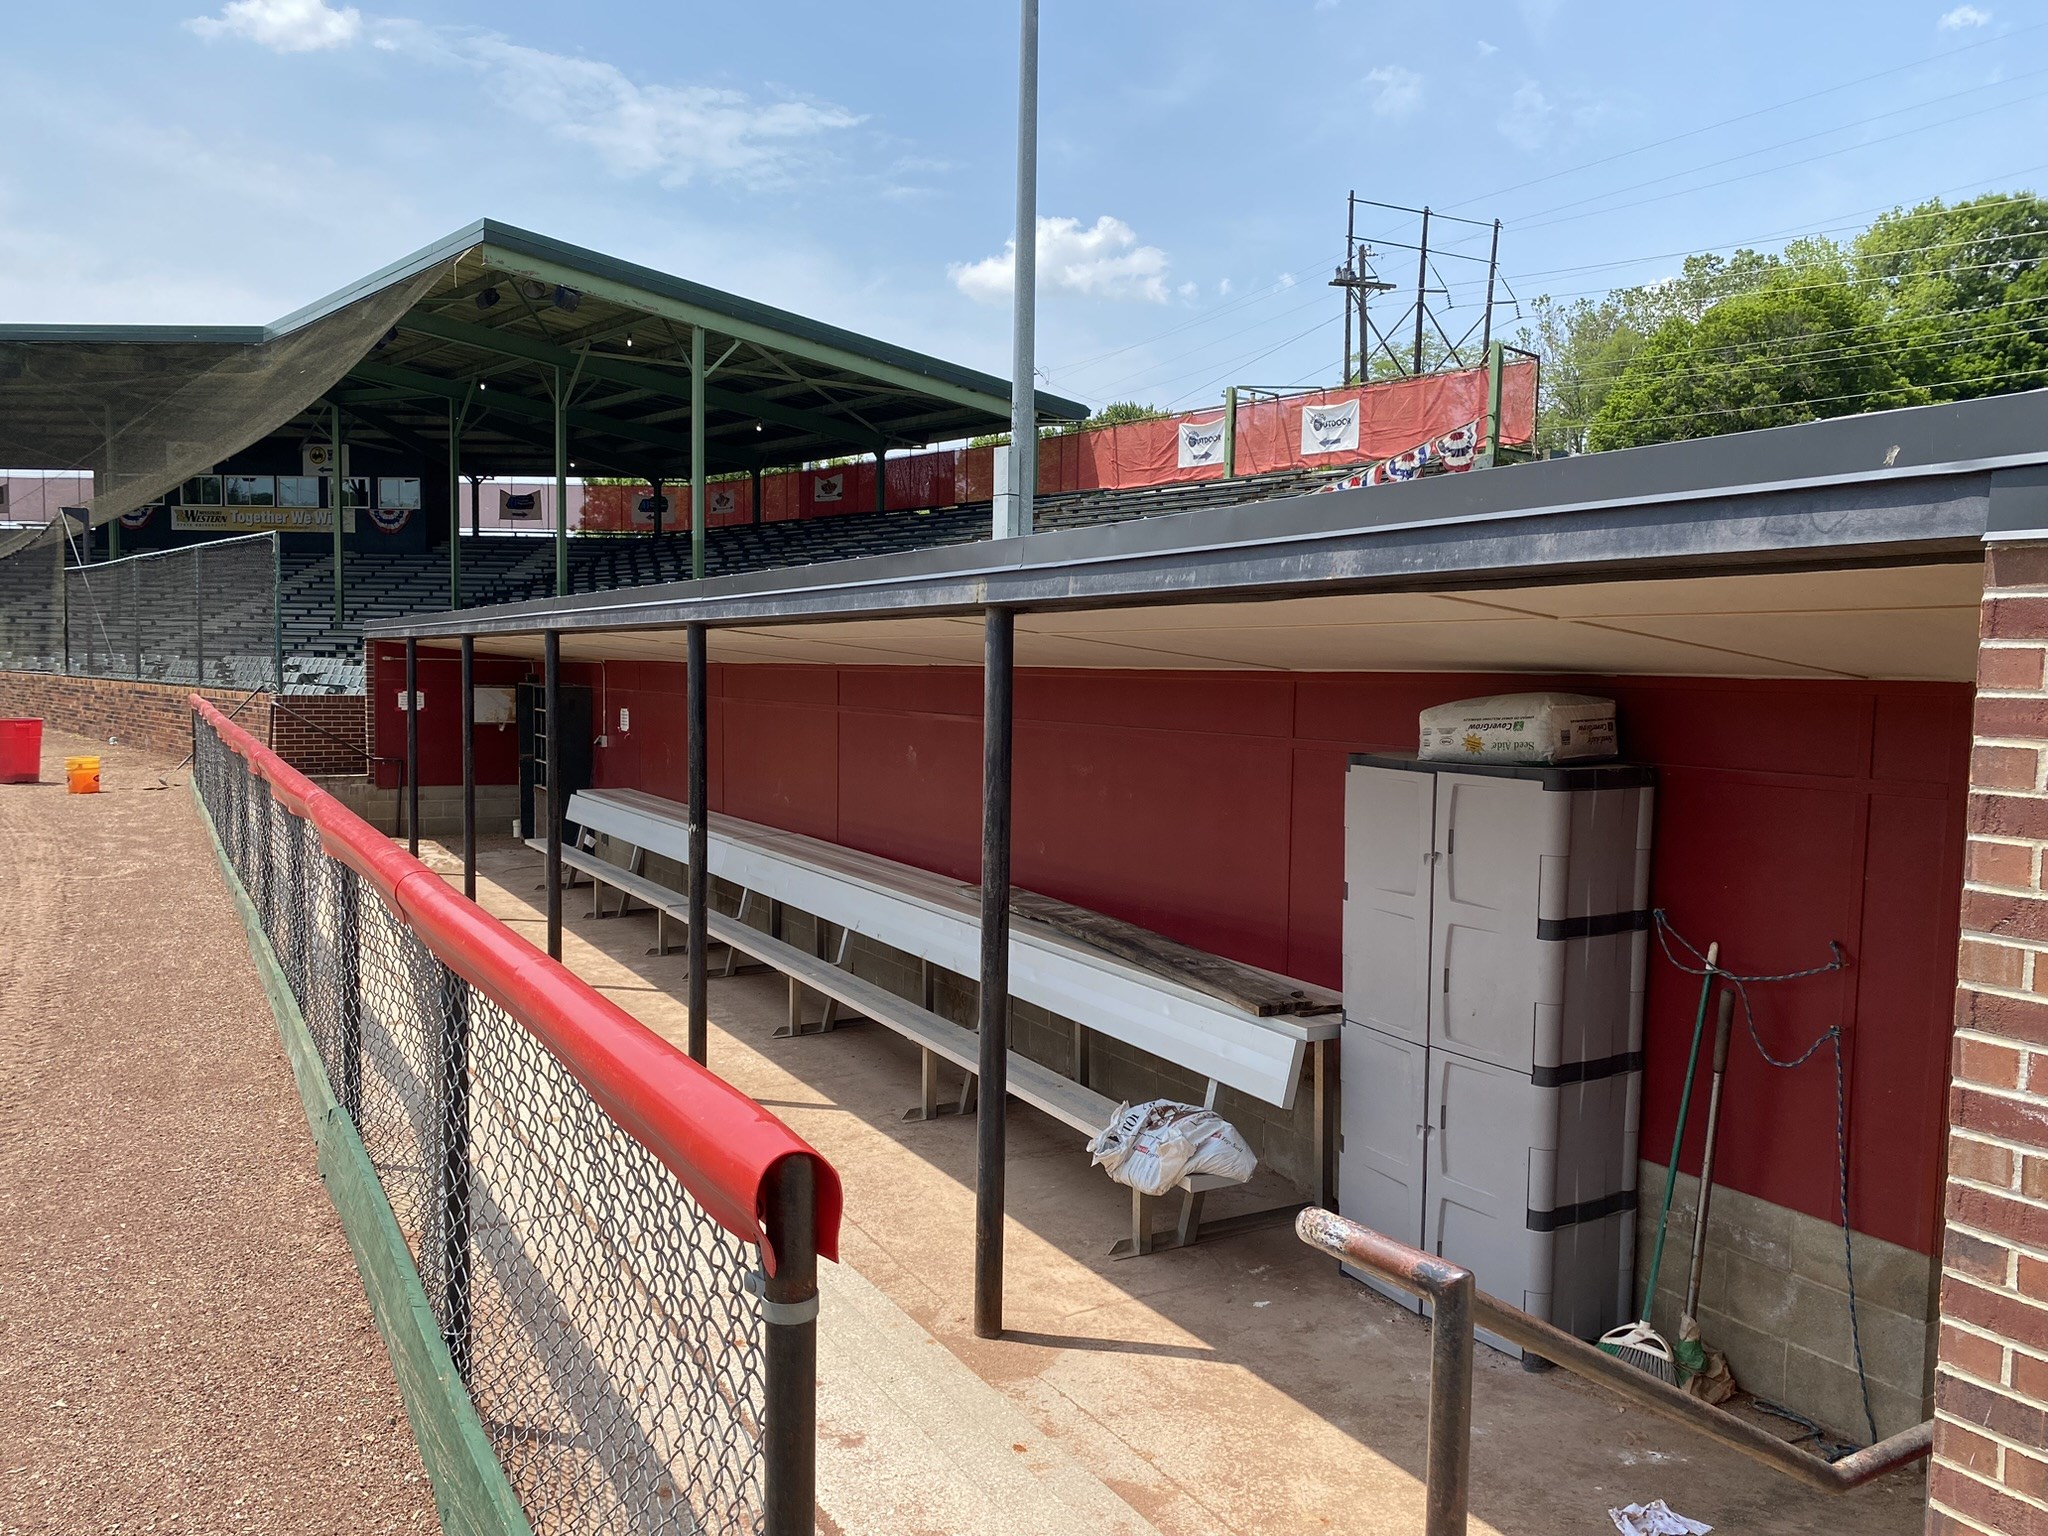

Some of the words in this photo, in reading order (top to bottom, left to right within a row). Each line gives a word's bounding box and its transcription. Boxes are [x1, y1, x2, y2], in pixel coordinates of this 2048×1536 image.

[184, 509, 228, 523] WESTERN
[229, 509, 289, 527] Together
[291, 510, 313, 525] We
[315, 511, 333, 526] Wi
[1467, 722, 1513, 732] CoverGrow
[1491, 741, 1512, 751] Aide
[1513, 741, 1535, 751] Seed
